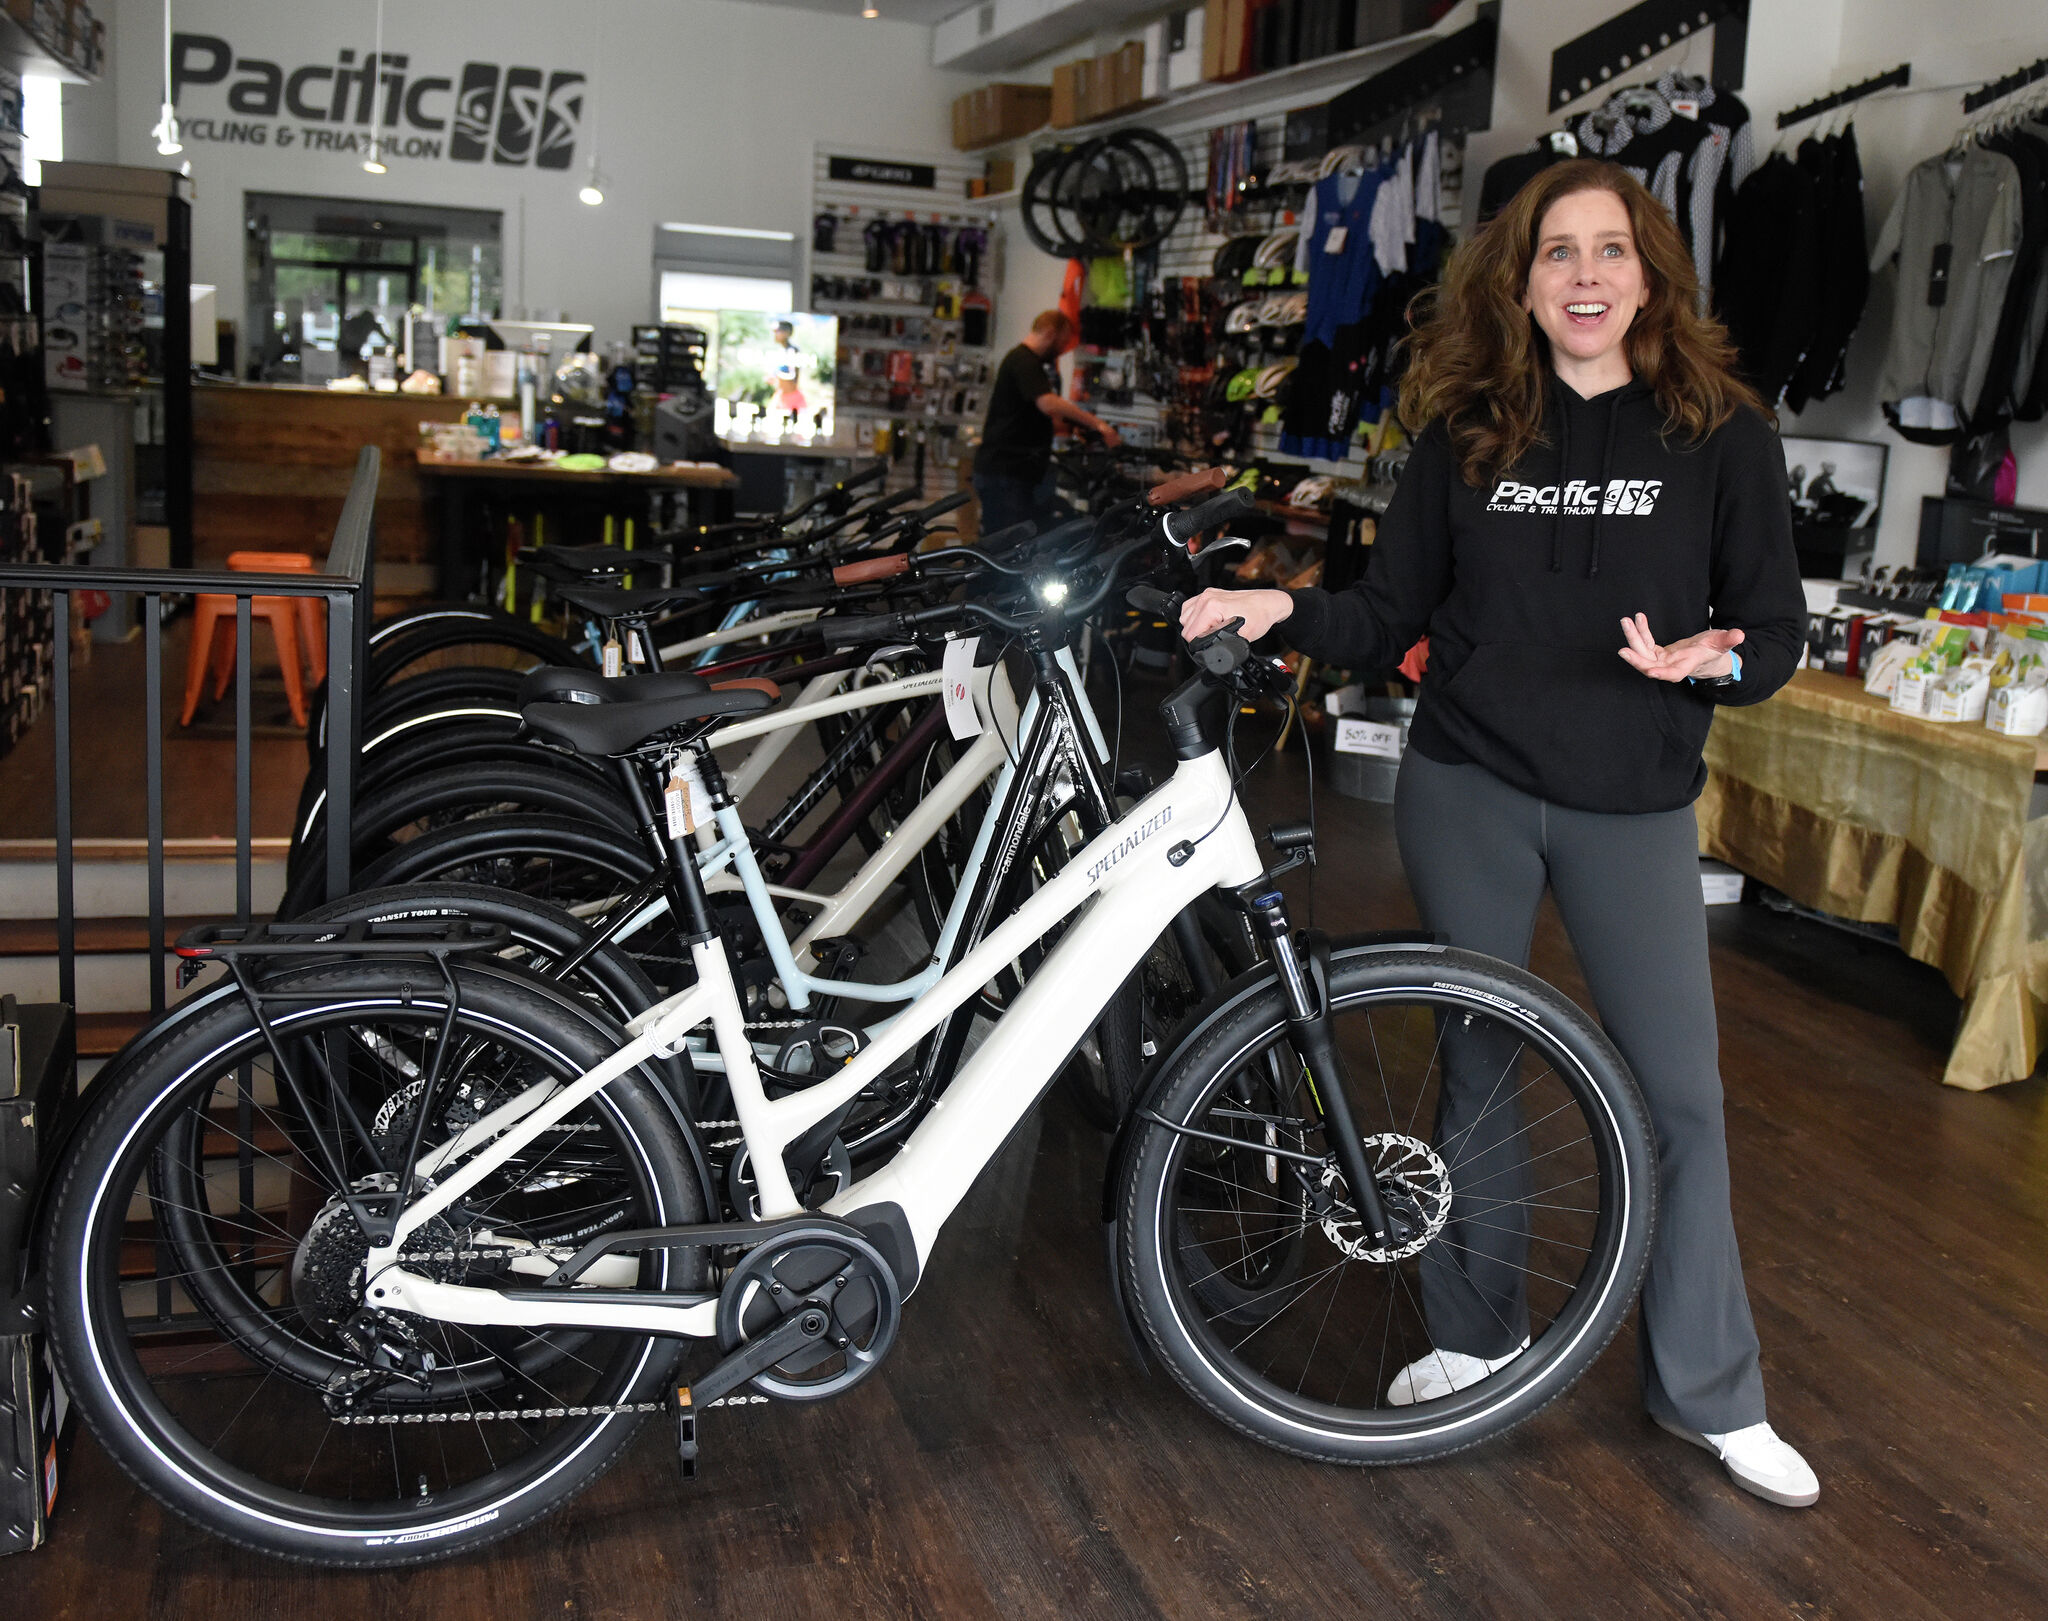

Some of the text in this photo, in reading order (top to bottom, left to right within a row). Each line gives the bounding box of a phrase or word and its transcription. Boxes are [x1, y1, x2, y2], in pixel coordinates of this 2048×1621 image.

[163, 32, 452, 131] Pacific
[173, 117, 268, 146] YCLING
[275, 125, 295, 147] &
[1490, 480, 1601, 506] Pacific
[1486, 503, 1597, 515] CYCLING & TRITHLON
[1001, 793, 1034, 874] cannondale
[1087, 805, 1172, 887] SPECIALIZED
[410, 909, 438, 917] TOUR
